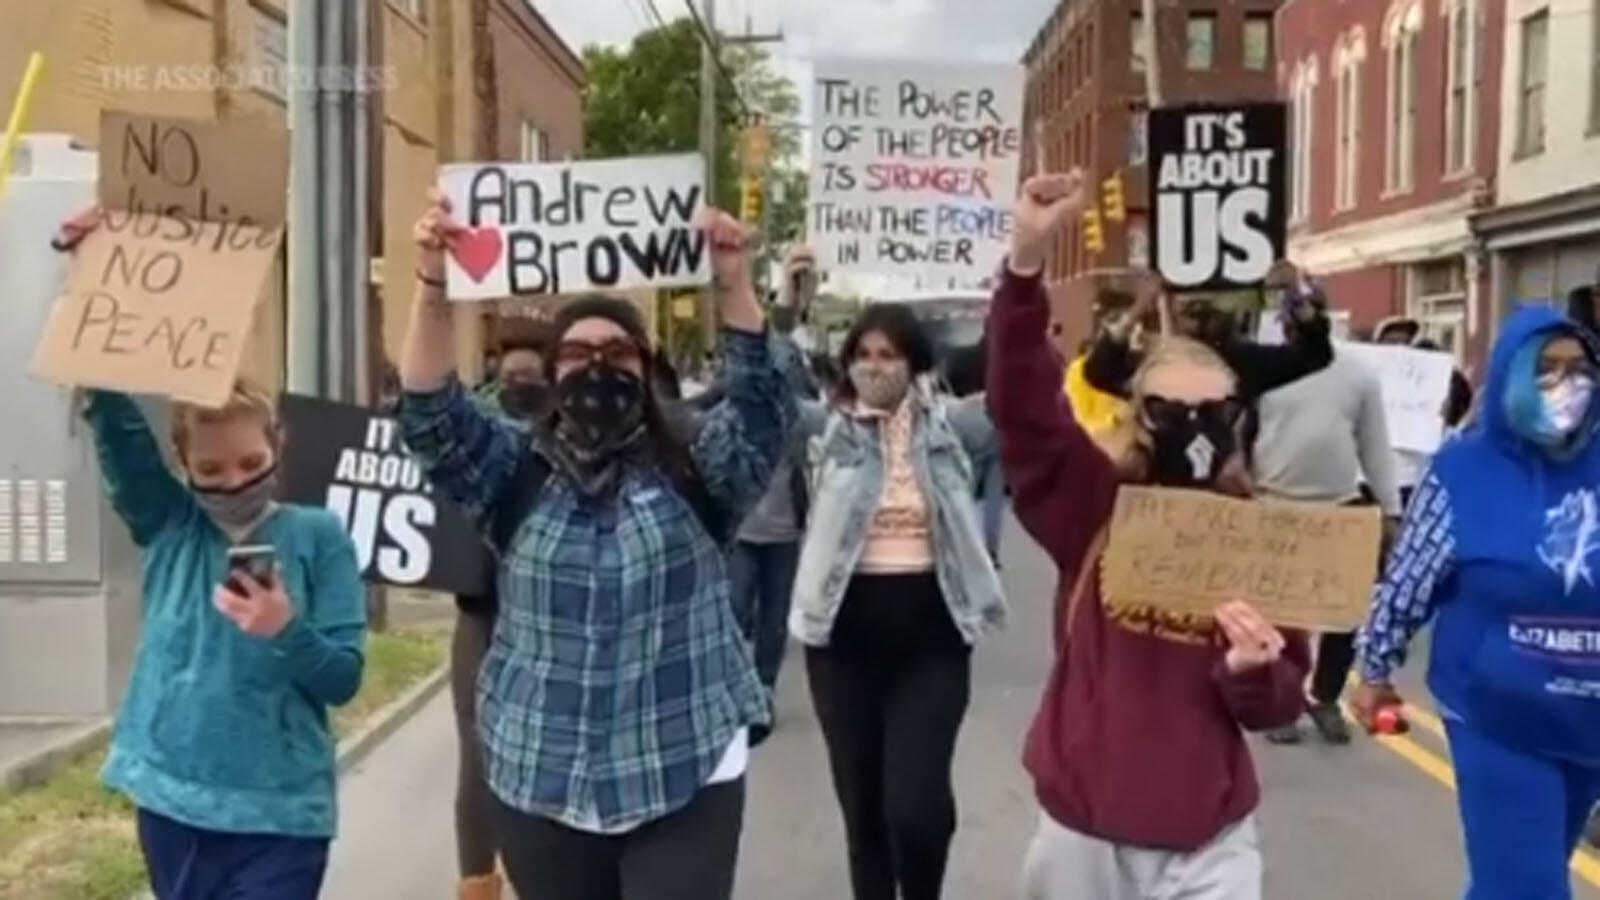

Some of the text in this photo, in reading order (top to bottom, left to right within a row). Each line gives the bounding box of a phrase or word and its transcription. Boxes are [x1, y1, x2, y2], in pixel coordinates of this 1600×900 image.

[816, 79, 1003, 123] THE POWER
[822, 124, 1019, 160] OF THE PEOPLE
[1185, 112, 1246, 150] IT'S
[120, 122, 199, 187] NO
[1157, 150, 1274, 189] ABOUT
[469, 166, 699, 227] Andrew
[821, 163, 993, 199] IS STRONGER
[813, 203, 1014, 240] THAN THE PEOPLE
[1157, 187, 1274, 286] US
[100, 245, 183, 293] NO
[837, 238, 974, 265] IN POWER
[72, 295, 229, 371] PEACE
[334, 448, 434, 493] ABOU
